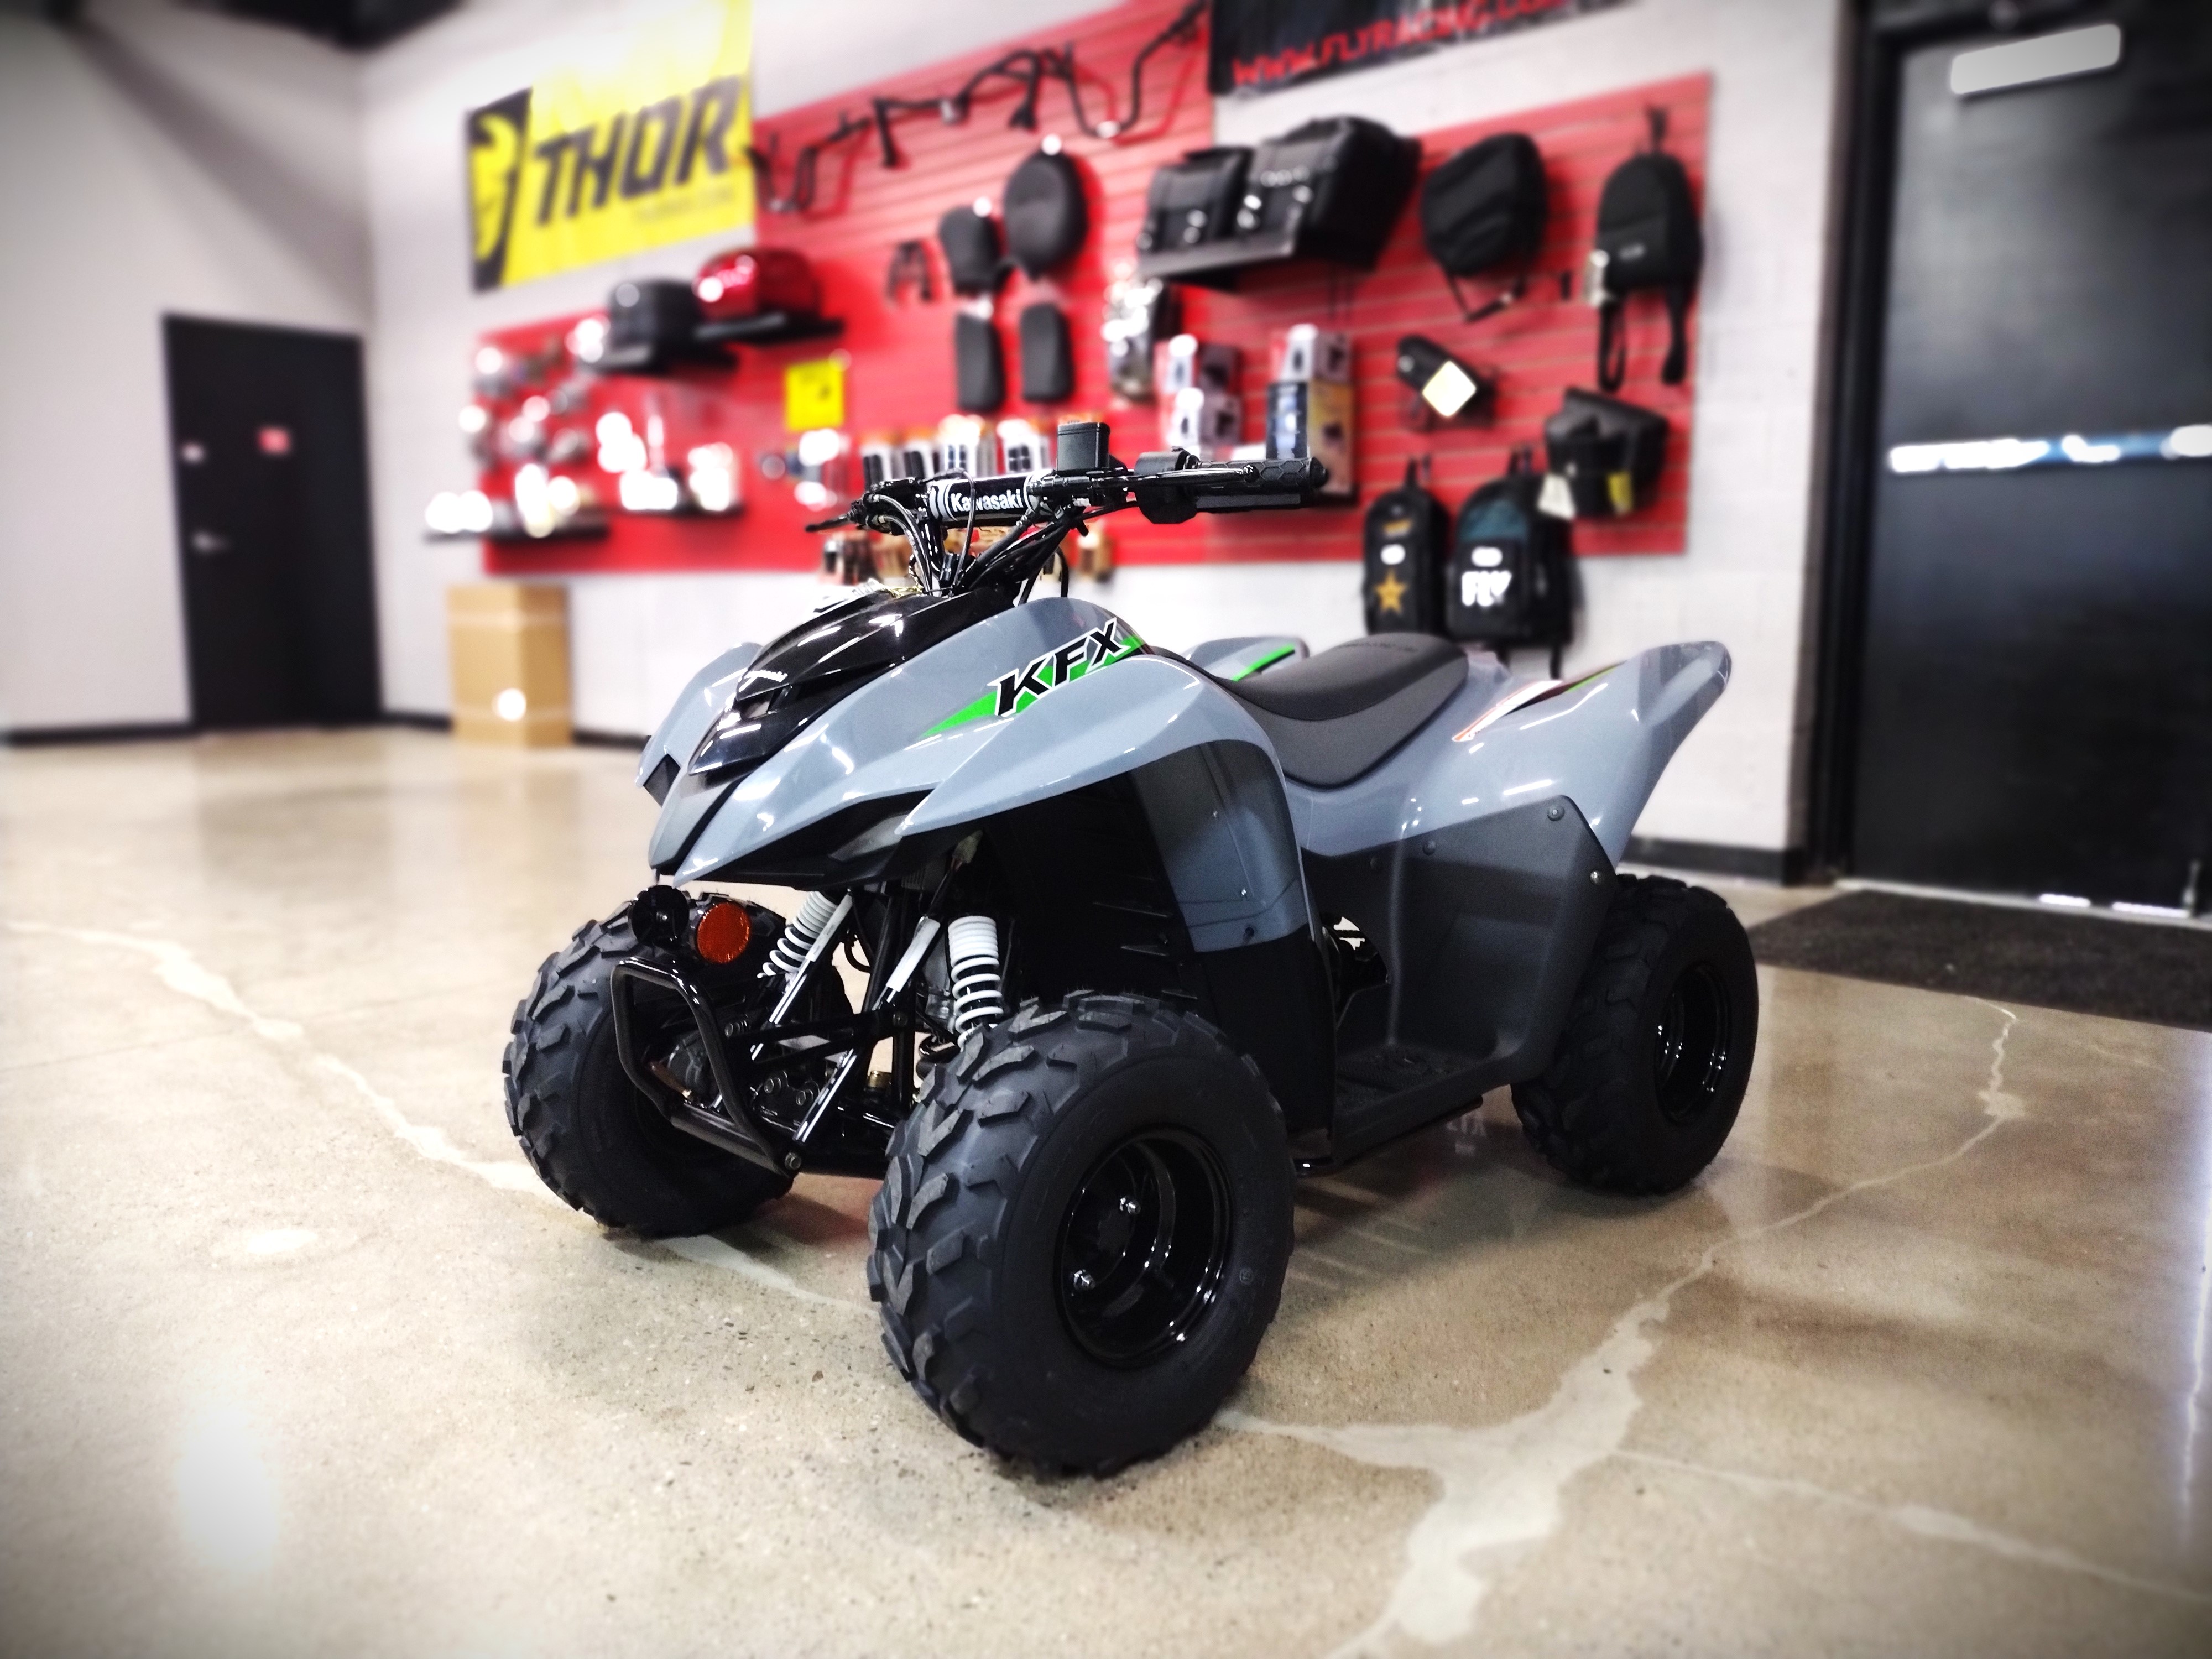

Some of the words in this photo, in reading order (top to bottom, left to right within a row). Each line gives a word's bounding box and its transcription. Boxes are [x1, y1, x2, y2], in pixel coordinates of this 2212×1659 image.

[1231, 0, 1566, 87] WWW.FLYRACING.CO
[534, 75, 742, 227] THOR
[951, 488, 1024, 512] Kawasaki
[988, 618, 1130, 717] KFX
